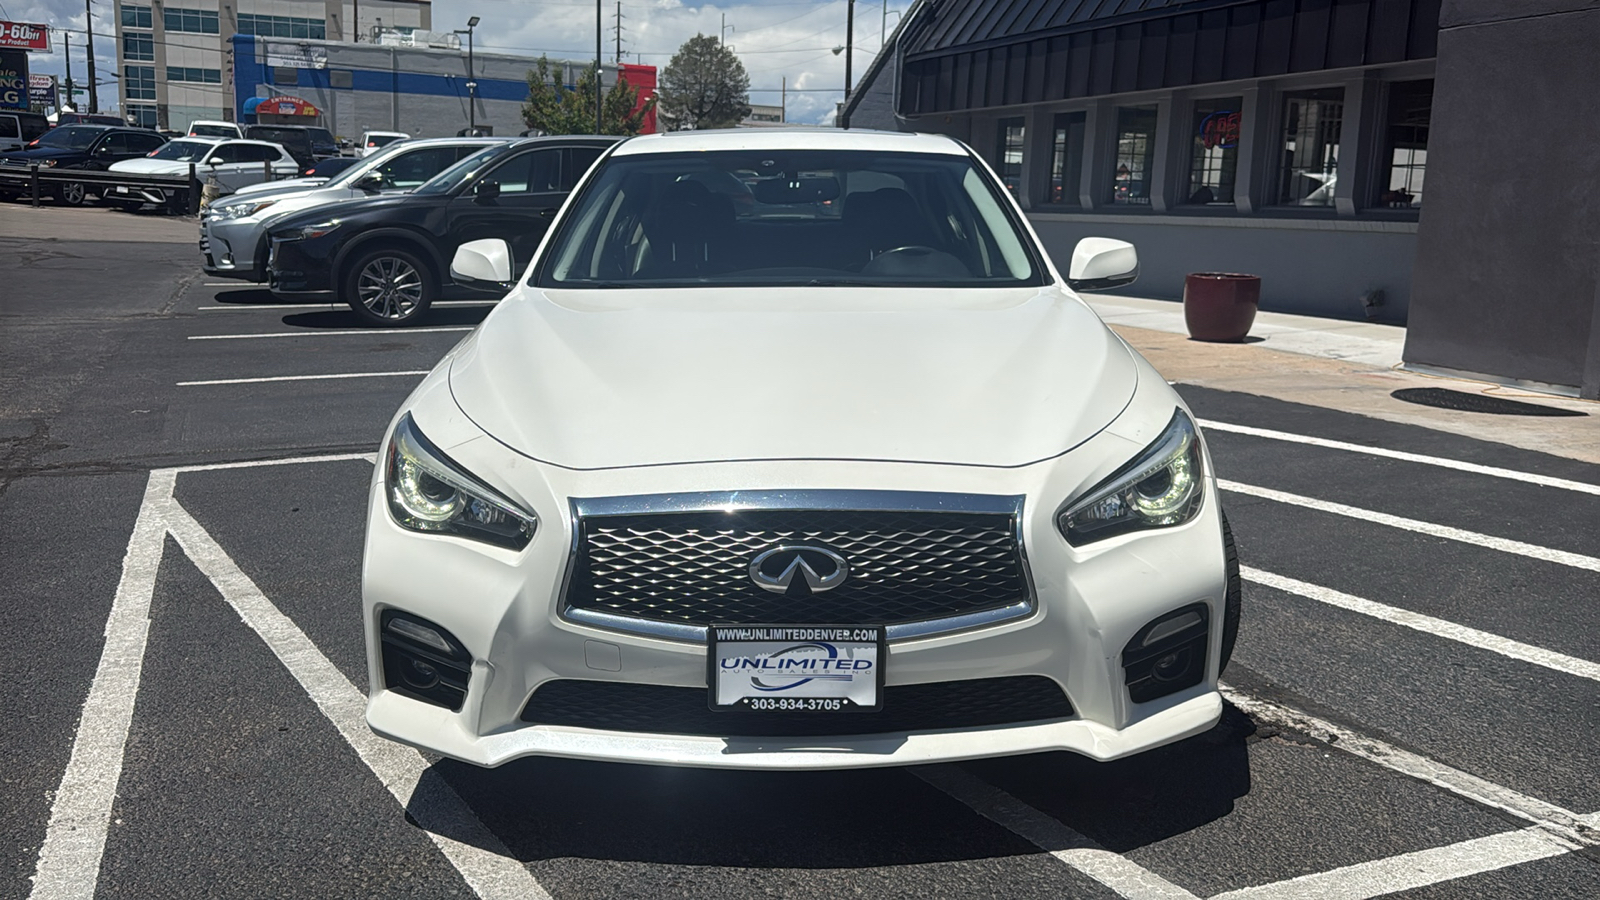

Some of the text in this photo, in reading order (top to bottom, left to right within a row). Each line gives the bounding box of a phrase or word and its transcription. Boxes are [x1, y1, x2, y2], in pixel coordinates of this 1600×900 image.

[271, 97, 304, 105] ENTRANCE
[1204, 112, 1242, 149] OPE
[716, 629, 877, 641] WWWUNLIMITEDDENVER.COM
[720, 658, 873, 670] UNLIMITED
[751, 698, 841, 710] 303-934-3705
